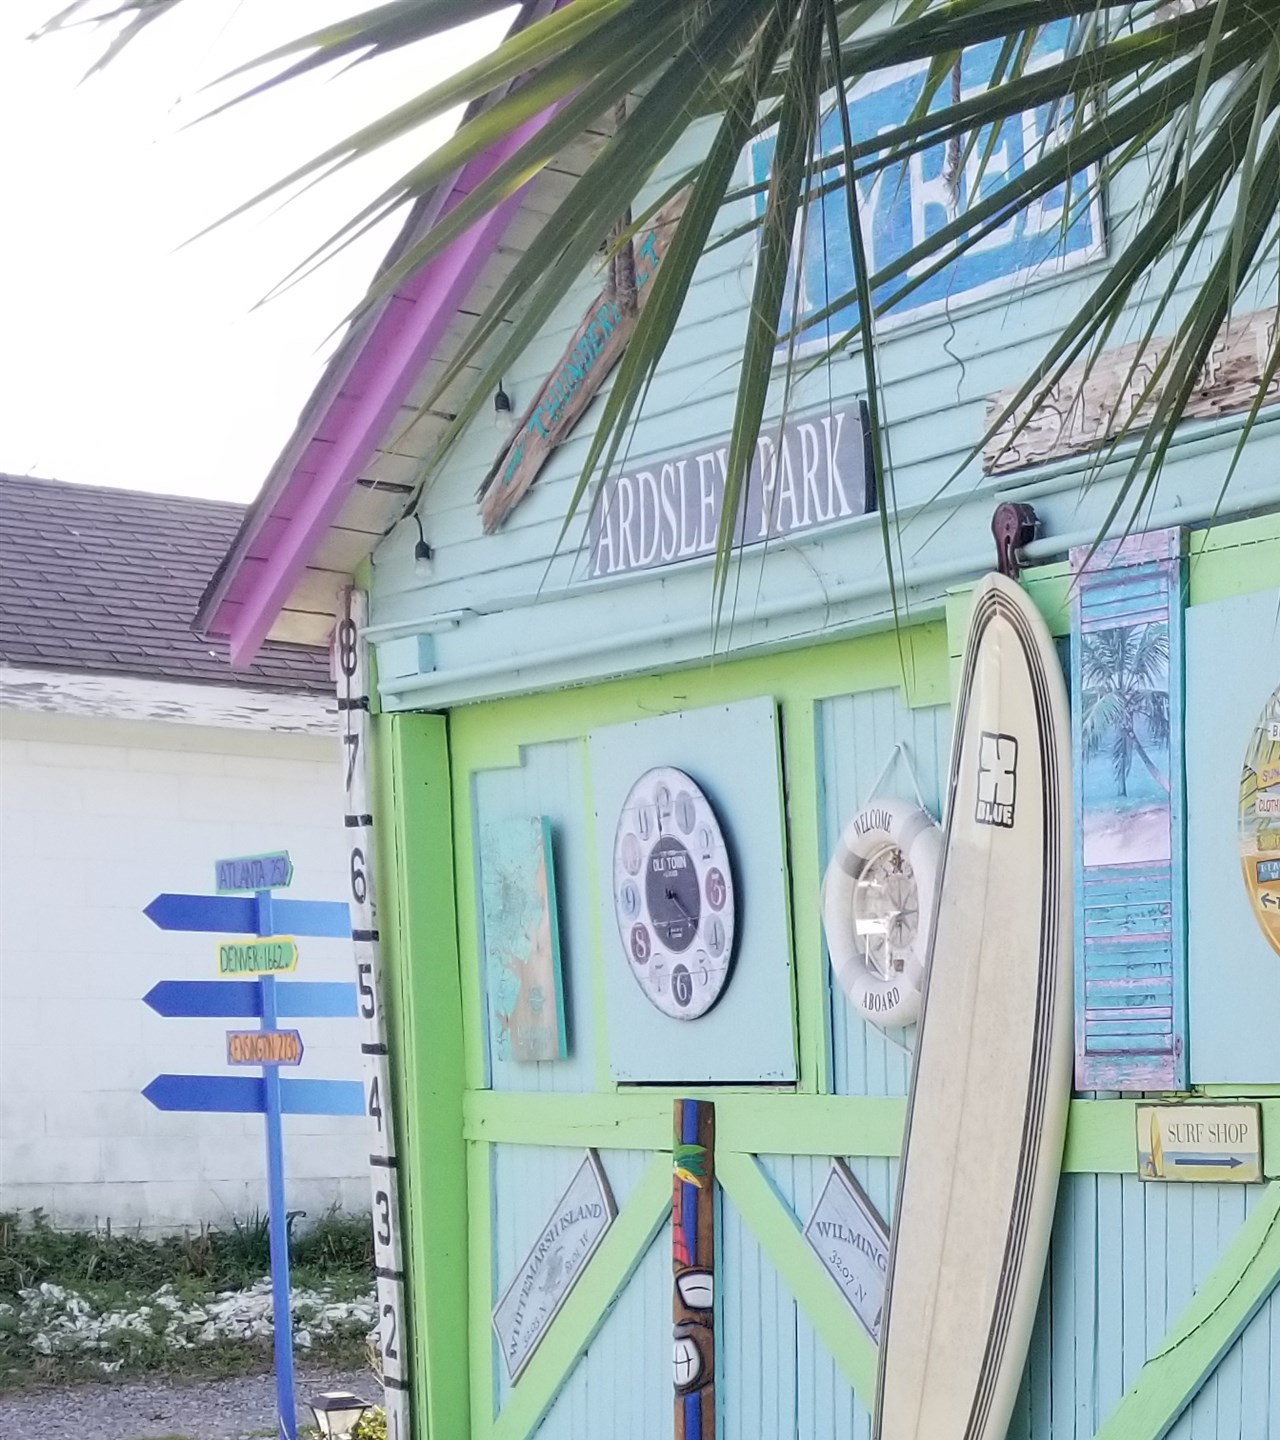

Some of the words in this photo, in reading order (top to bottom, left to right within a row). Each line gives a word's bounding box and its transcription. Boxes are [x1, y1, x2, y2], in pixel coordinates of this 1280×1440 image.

[527, 230, 660, 440] THUNDERLT
[757, 412, 853, 537] PARK
[342, 734, 360, 792] 7
[853, 808, 894, 838] WELCOME
[218, 859, 266, 890] ATLANTA
[350, 847, 368, 905] 6
[219, 943, 259, 973] DENVER
[357, 963, 375, 1021] 5
[861, 985, 901, 1013] ABOARD
[368, 1075, 383, 1133] 4
[1167, 1123, 1204, 1144] SURF
[1208, 1123, 1249, 1144] SHOP
[375, 1190, 390, 1248] 3
[560, 1202, 602, 1233] ISLAND
[382, 1303, 398, 1361] 2
